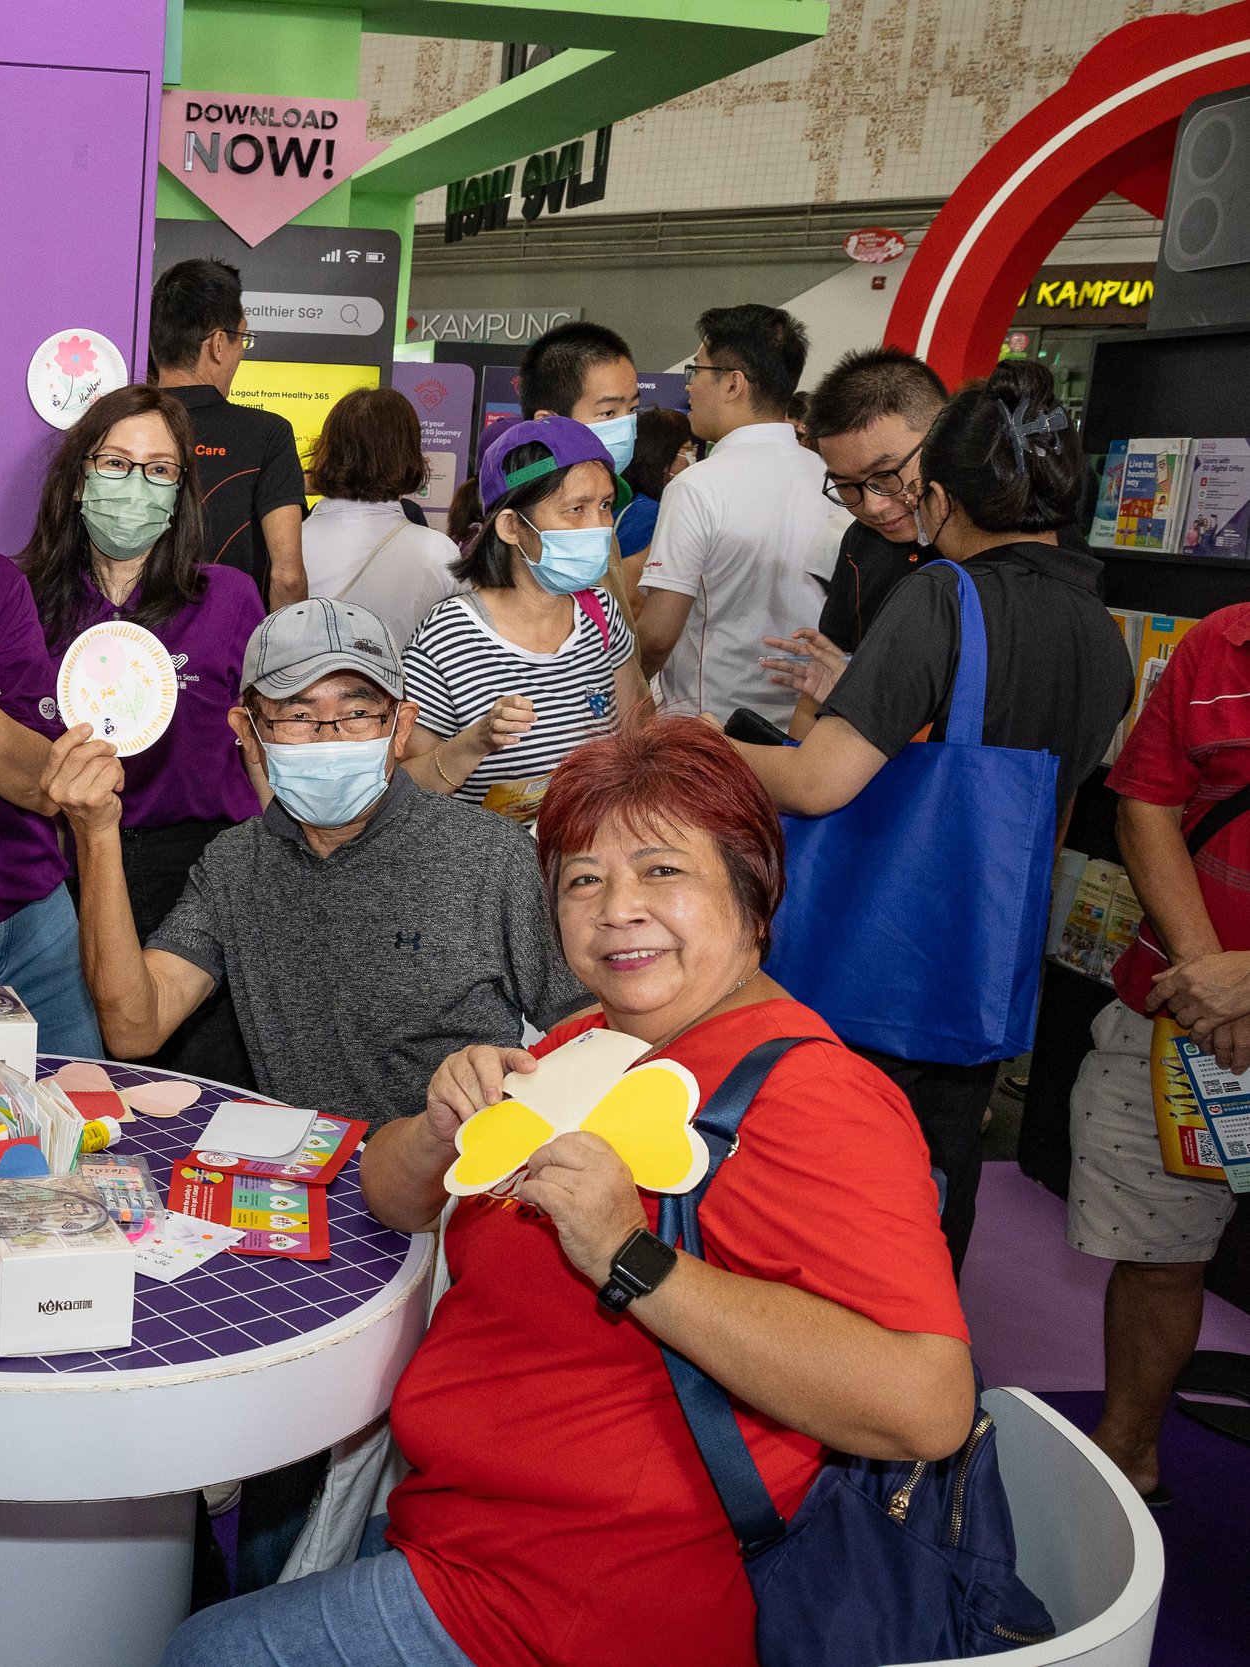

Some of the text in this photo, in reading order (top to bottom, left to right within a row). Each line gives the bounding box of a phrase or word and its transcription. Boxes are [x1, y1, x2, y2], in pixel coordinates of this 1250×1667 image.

[186, 102, 338, 130] DOWNLOAD
[184, 131, 336, 180] NOW!
[243, 305, 324, 319] ealthier SG?
[230, 390, 330, 401] Logout from Healthy 365
[429, 421, 446, 430] your
[425, 429, 462, 441] SG journey
[432, 438, 452, 448] steps
[195, 445, 227, 456] Care
[1129, 459, 1154, 469] Live the
[1127, 470, 1157, 479] healthier
[1126, 480, 1140, 488] way
[182, 673, 200, 682] Seeds
[41, 703, 55, 714] SG
